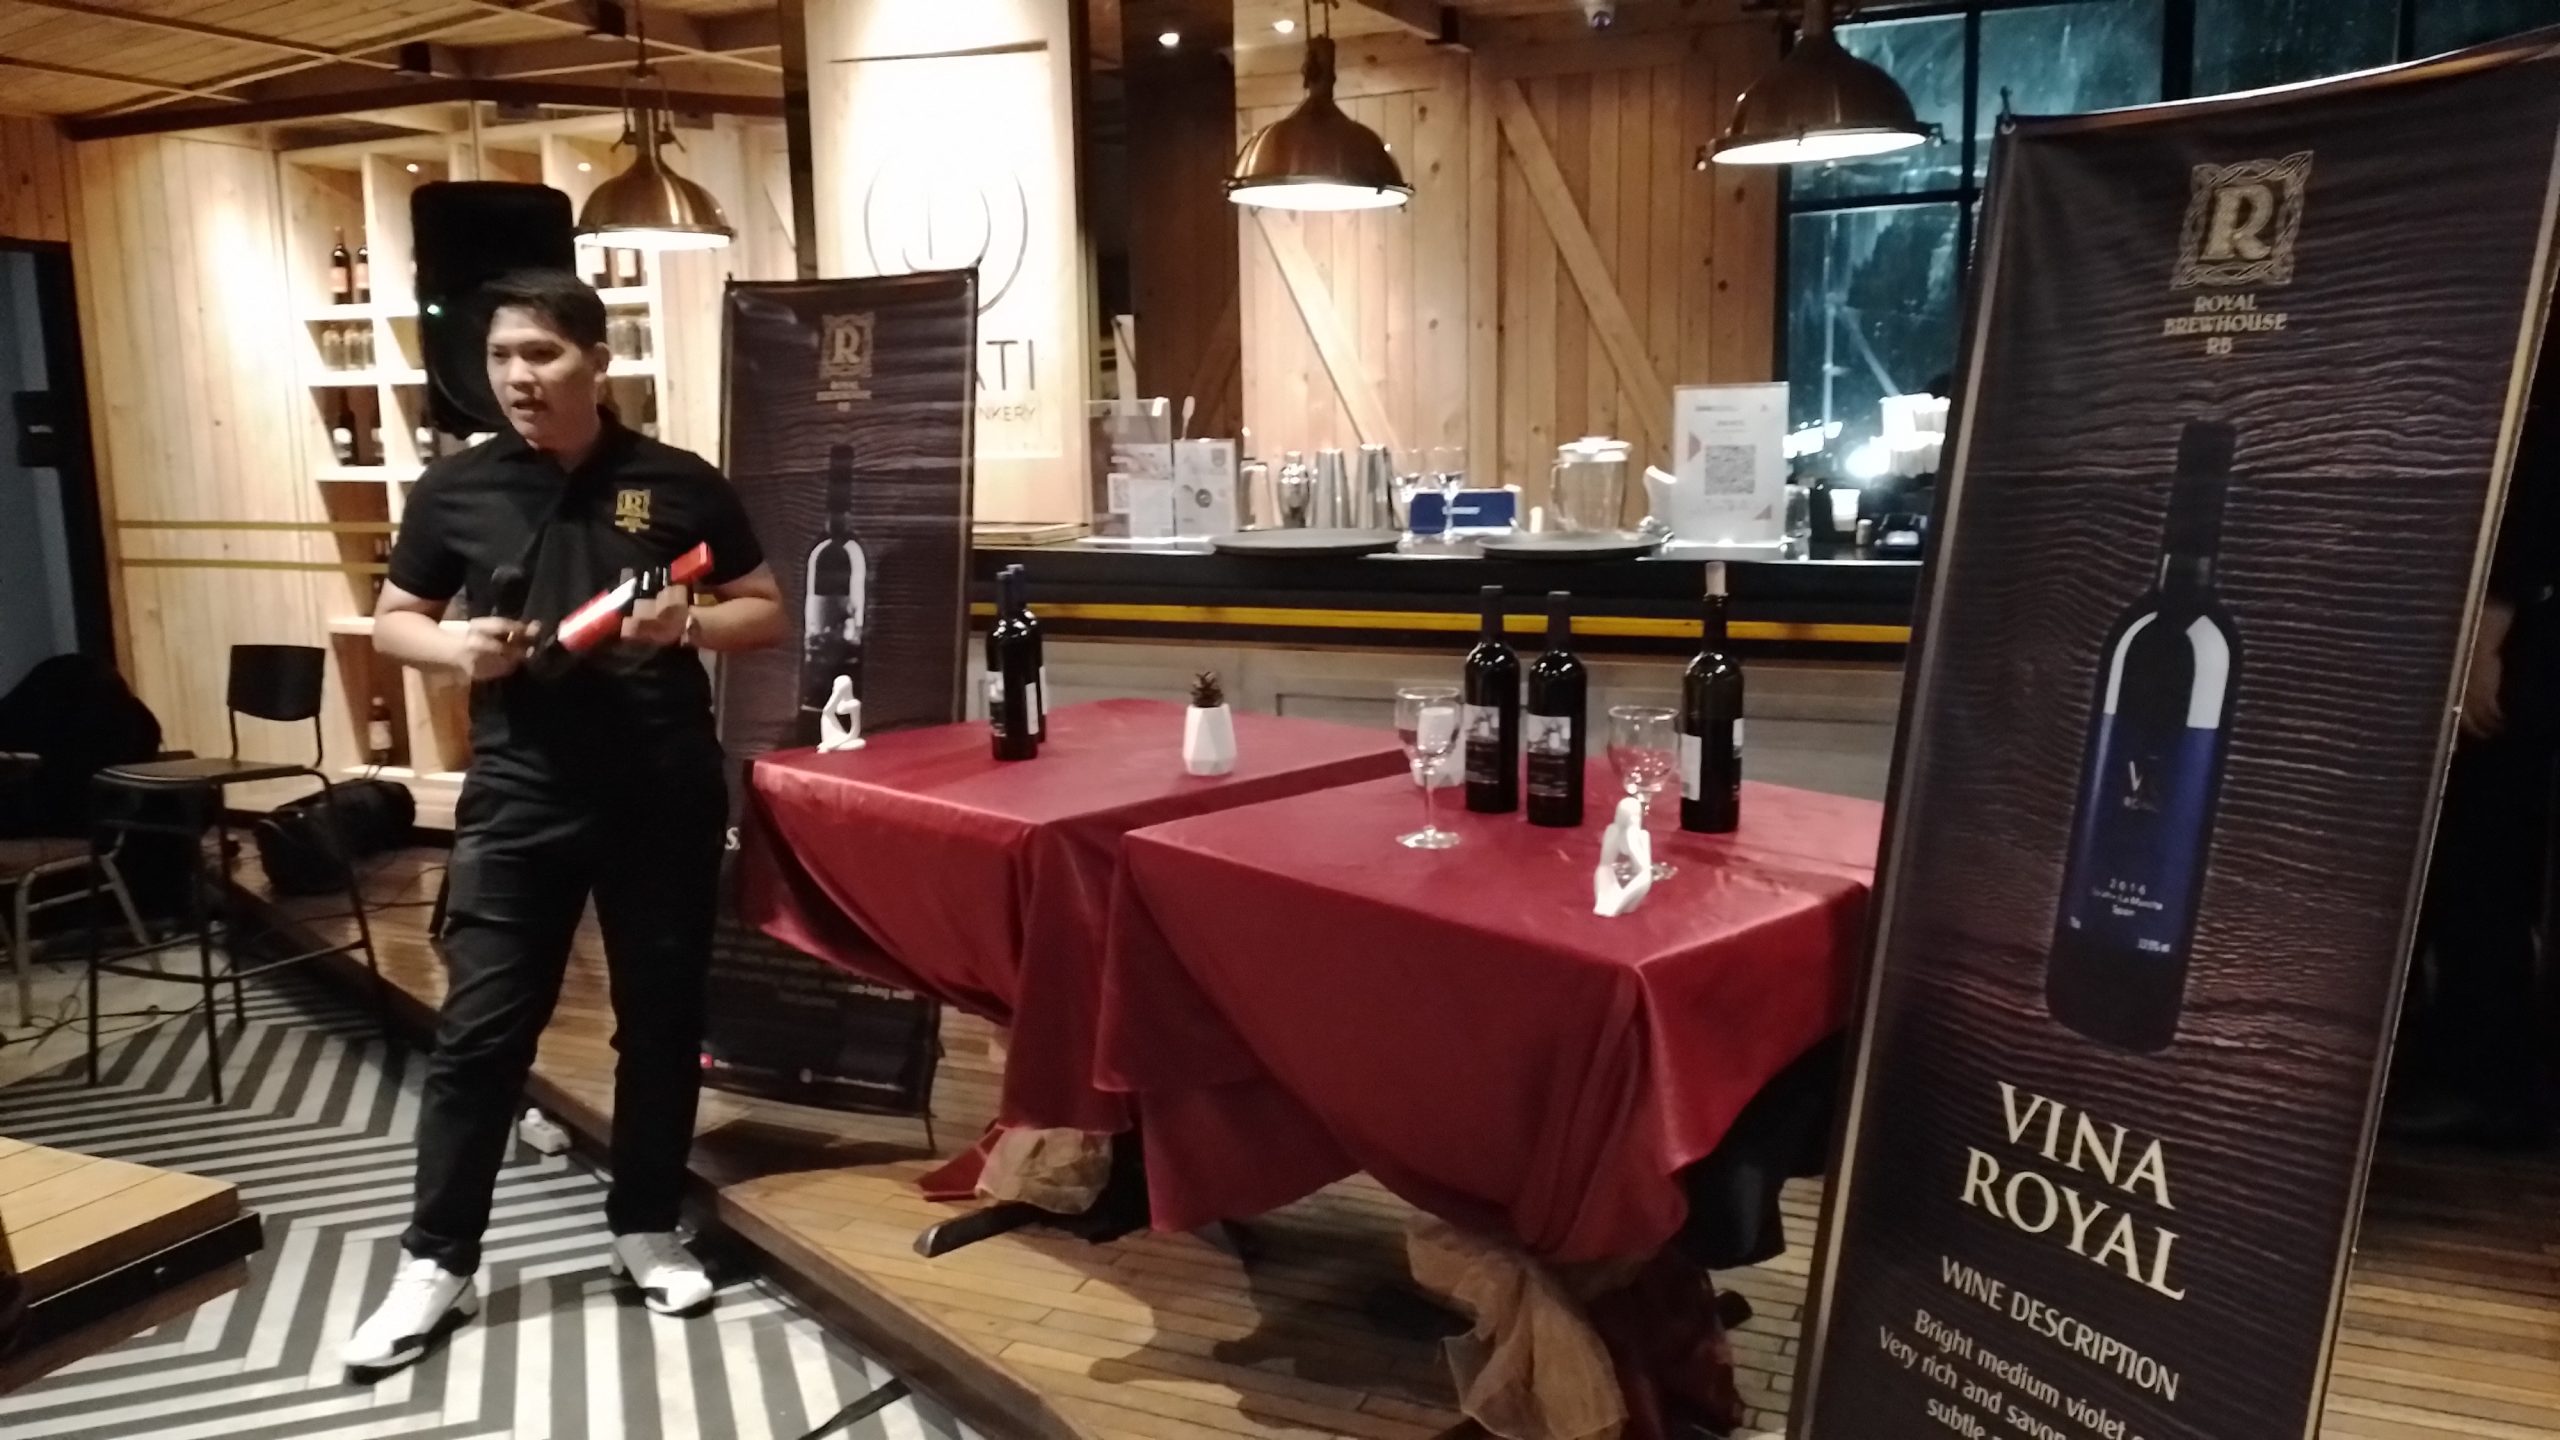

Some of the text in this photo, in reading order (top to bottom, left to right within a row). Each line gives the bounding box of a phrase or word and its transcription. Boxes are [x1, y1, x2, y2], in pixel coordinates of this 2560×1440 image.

[2200, 184, 2273, 260] R
[2162, 313, 2289, 337] BREWHOUSE
[2194, 294, 2259, 313] ROYAL
[1999, 1080, 2176, 1211] VINA
[1960, 1146, 2186, 1301] ROYAL
[1879, 1325, 1919, 1370] Very
[1921, 1354, 1958, 1390] rich
[1962, 1378, 2003, 1415] and
[1941, 1255, 2180, 1402] WINE DESCRIPTION
[1914, 1309, 2128, 1440] Bright medium violet
[1926, 1398, 1986, 1440] subtle
